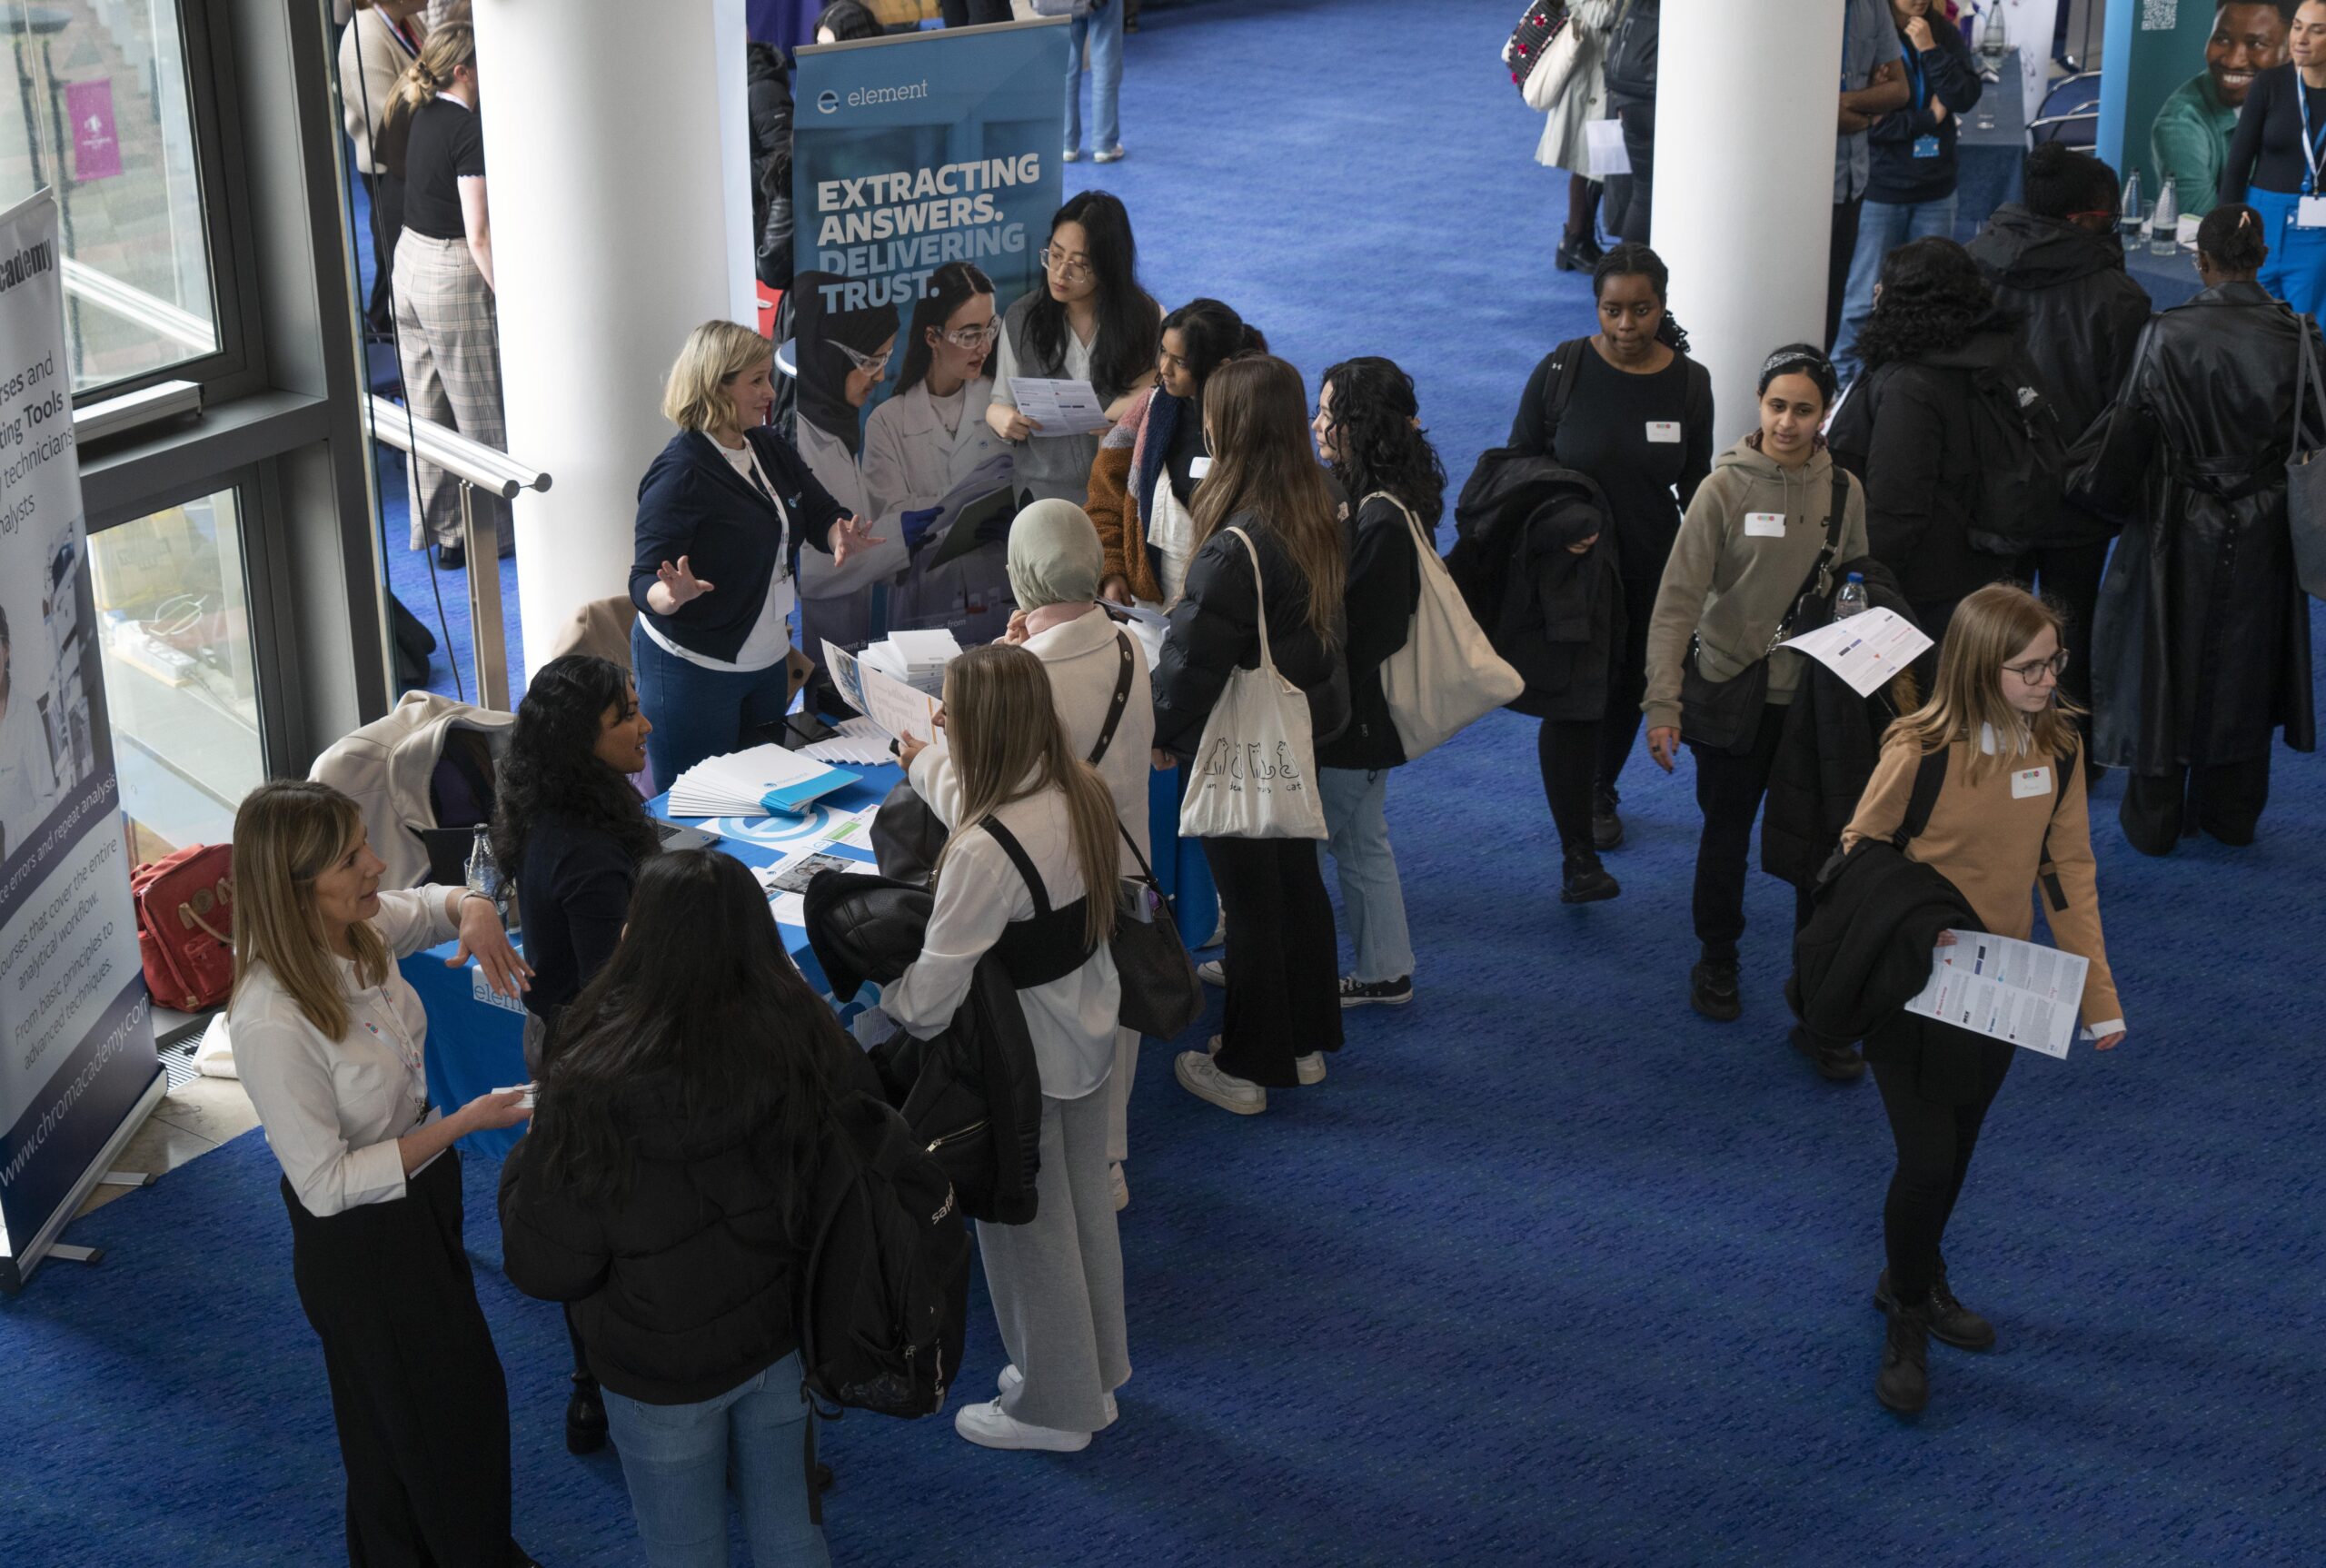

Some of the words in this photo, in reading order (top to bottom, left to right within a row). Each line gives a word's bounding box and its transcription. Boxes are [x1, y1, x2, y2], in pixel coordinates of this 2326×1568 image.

[848, 79, 928, 107] element
[818, 153, 1040, 212] EXTRACTING
[817, 194, 1004, 246] ANSWERS.
[819, 223, 1026, 278] DELIVERING
[819, 269, 940, 314] TRUST.
[27, 349, 54, 386] and
[23, 390, 64, 428] Tools
[4, 427, 73, 489] technicians
[1286, 781, 1303, 792] cat
[9, 854, 37, 891] errors
[36, 831, 55, 862] and
[53, 805, 82, 844] repeat
[81, 773, 116, 814] analysis
[0, 933, 29, 981] ourses
[28, 909, 49, 942] that
[48, 881, 74, 919] cover
[74, 866, 89, 891] the
[89, 838, 118, 873] entire
[17, 930, 58, 991] analytical
[58, 890, 100, 944] workflow.
[15, 1008, 40, 1046] From
[39, 979, 63, 1017] basic
[63, 935, 103, 994] principles
[102, 920, 114, 941] to
[473, 983, 528, 1013] elem
[24, 1006, 67, 1070] advanced
[65, 957, 114, 1020] techniques.
[0, 992, 149, 1187] www.chromacademy.com
